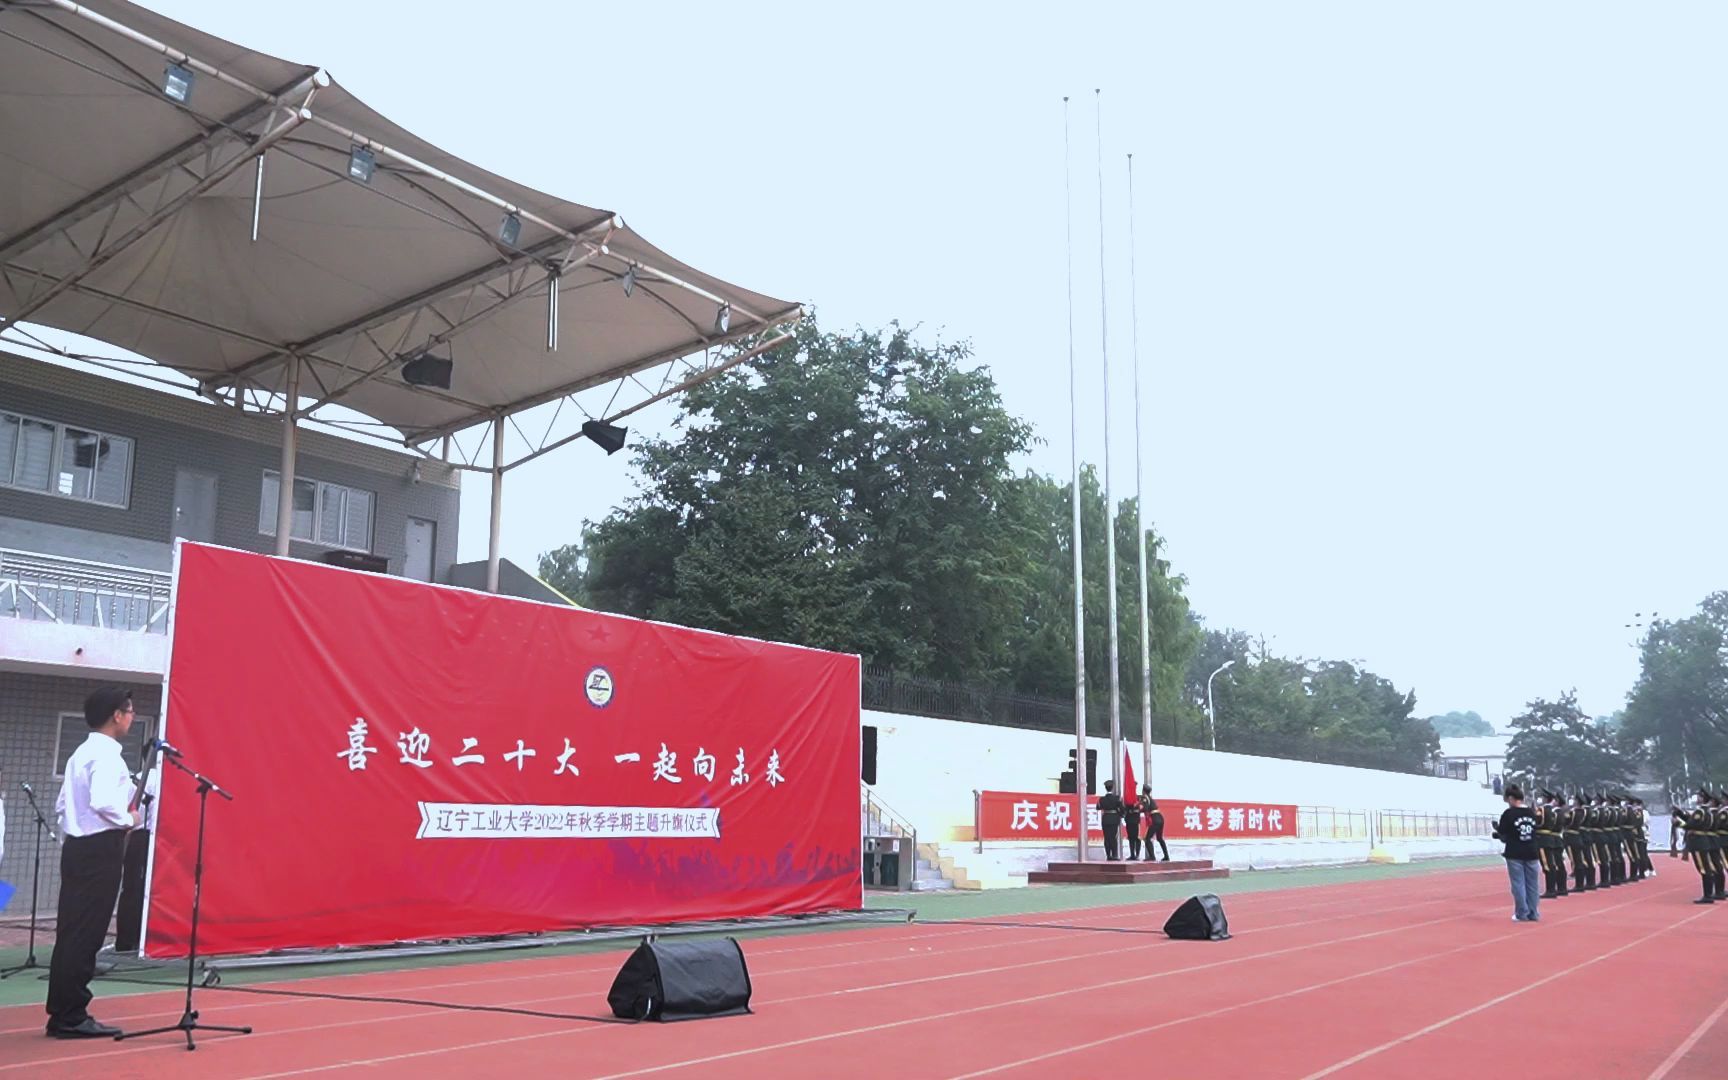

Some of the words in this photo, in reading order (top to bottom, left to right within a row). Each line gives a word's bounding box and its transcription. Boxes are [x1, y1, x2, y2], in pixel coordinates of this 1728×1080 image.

[337, 717, 580, 777] 喜迎二十大
[614, 742, 785, 788] 一起向未来
[436, 809, 708, 832] 辽宁工业大学2022年秋季学期主题升旗仪式
[1183, 805, 1283, 831] 筑梦新时代
